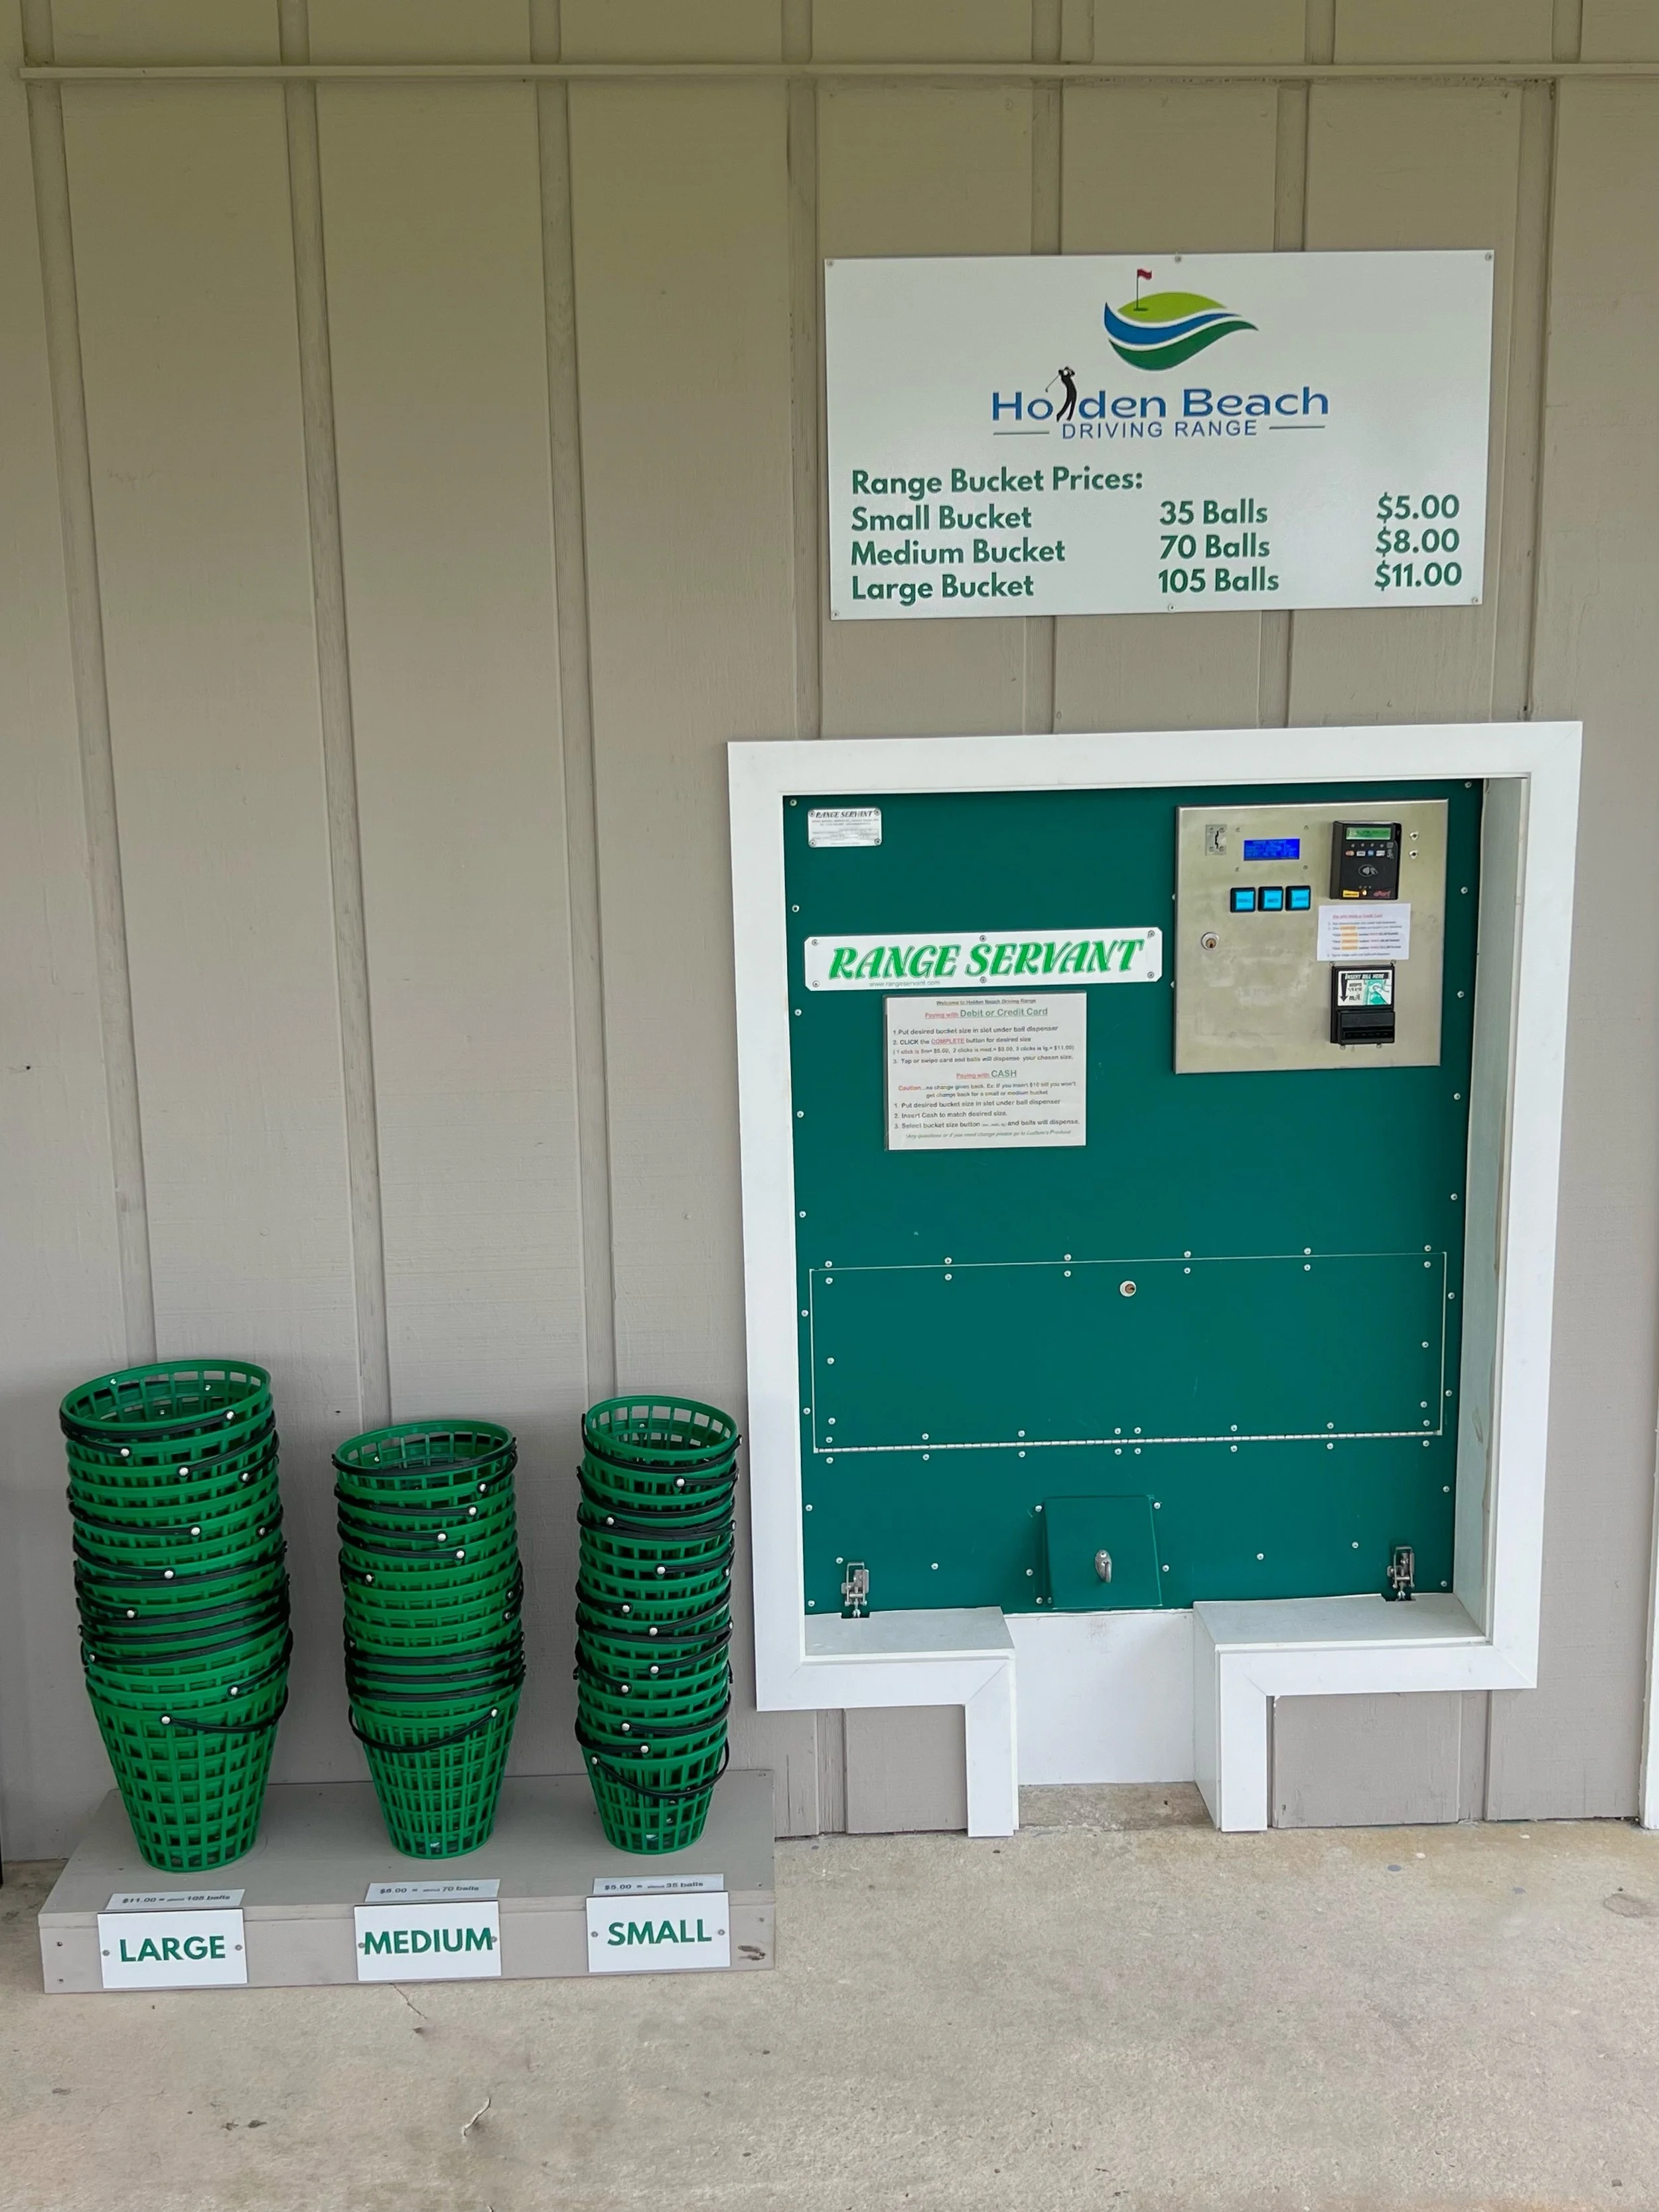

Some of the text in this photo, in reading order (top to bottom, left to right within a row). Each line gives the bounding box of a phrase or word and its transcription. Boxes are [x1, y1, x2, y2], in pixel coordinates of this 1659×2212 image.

[1183, 386, 1329, 419] Beach
[1062, 419, 1258, 439] DRIVING RANGE
[852, 465, 1144, 501] Range Bucket Prices:
[851, 492, 1460, 531] Small Bucket 35 Balls $5.00
[851, 526, 1460, 565] Medium Bucket 70 Balls $8.00
[852, 560, 1462, 607] Large Bucket 105 Balls $11.00
[828, 939, 1145, 980] RANGE SERVANT
[119, 1935, 226, 1962] LARGE
[364, 1927, 493, 1954] MEDIUM
[607, 1919, 712, 1946] SMALL
